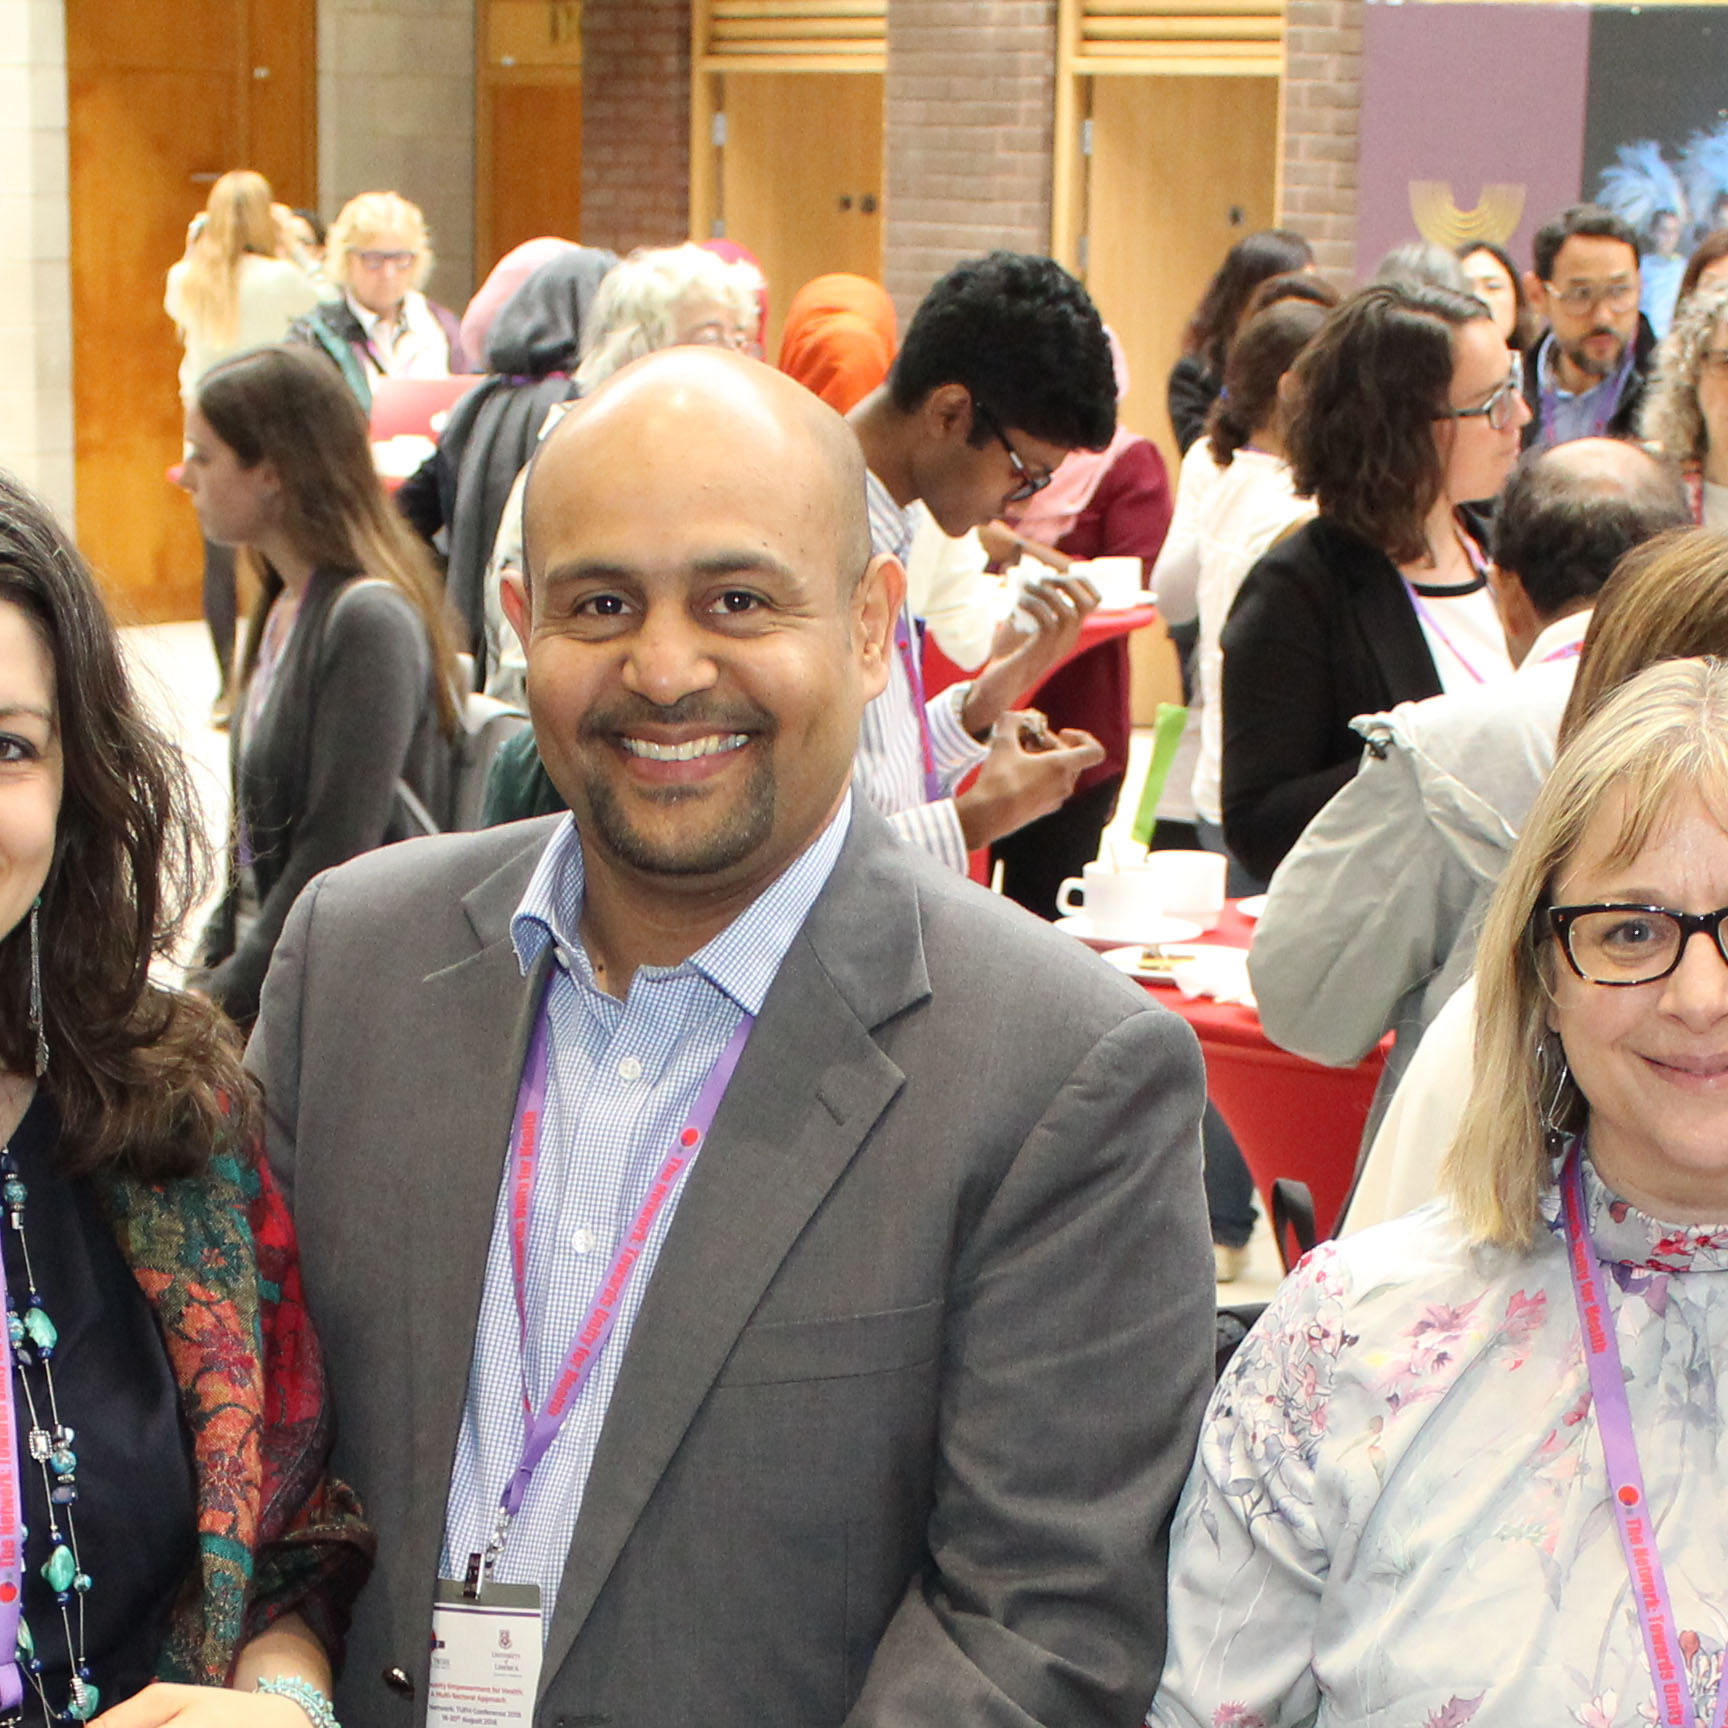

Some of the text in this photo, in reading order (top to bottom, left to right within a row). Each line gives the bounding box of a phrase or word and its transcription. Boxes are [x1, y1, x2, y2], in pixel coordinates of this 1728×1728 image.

[1626, 1517, 1644, 1545] The
[1648, 1614, 1675, 1681] Towards
[1663, 1683, 1684, 1725] Unity
